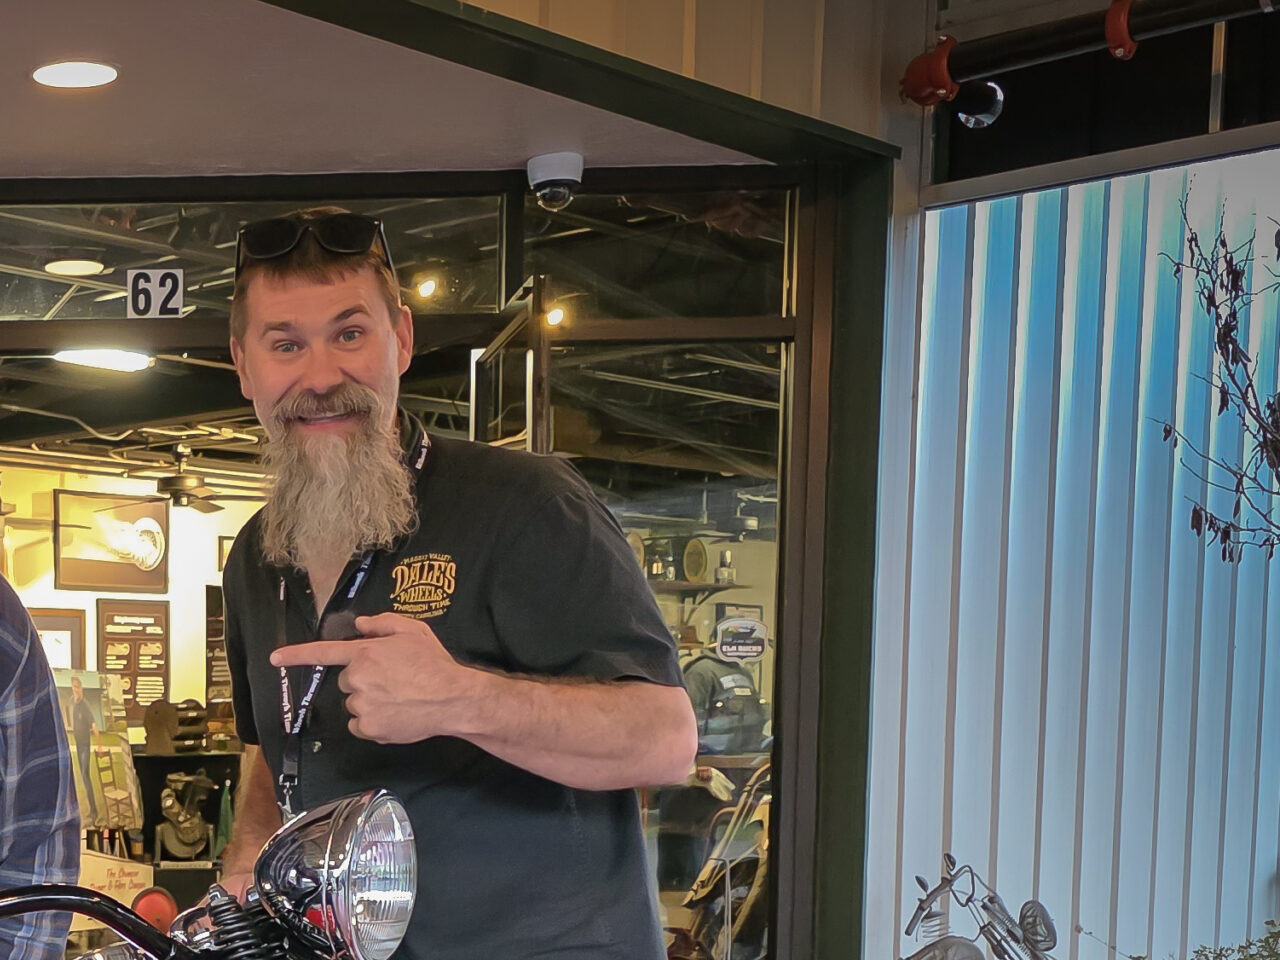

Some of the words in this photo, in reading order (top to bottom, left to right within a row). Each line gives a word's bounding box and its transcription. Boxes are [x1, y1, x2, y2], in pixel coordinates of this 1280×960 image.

[131, 271, 180, 317] 62
[400, 585, 443, 603] WHEELS
[393, 602, 428, 612] THROUGH
[430, 598, 451, 610] TIME
